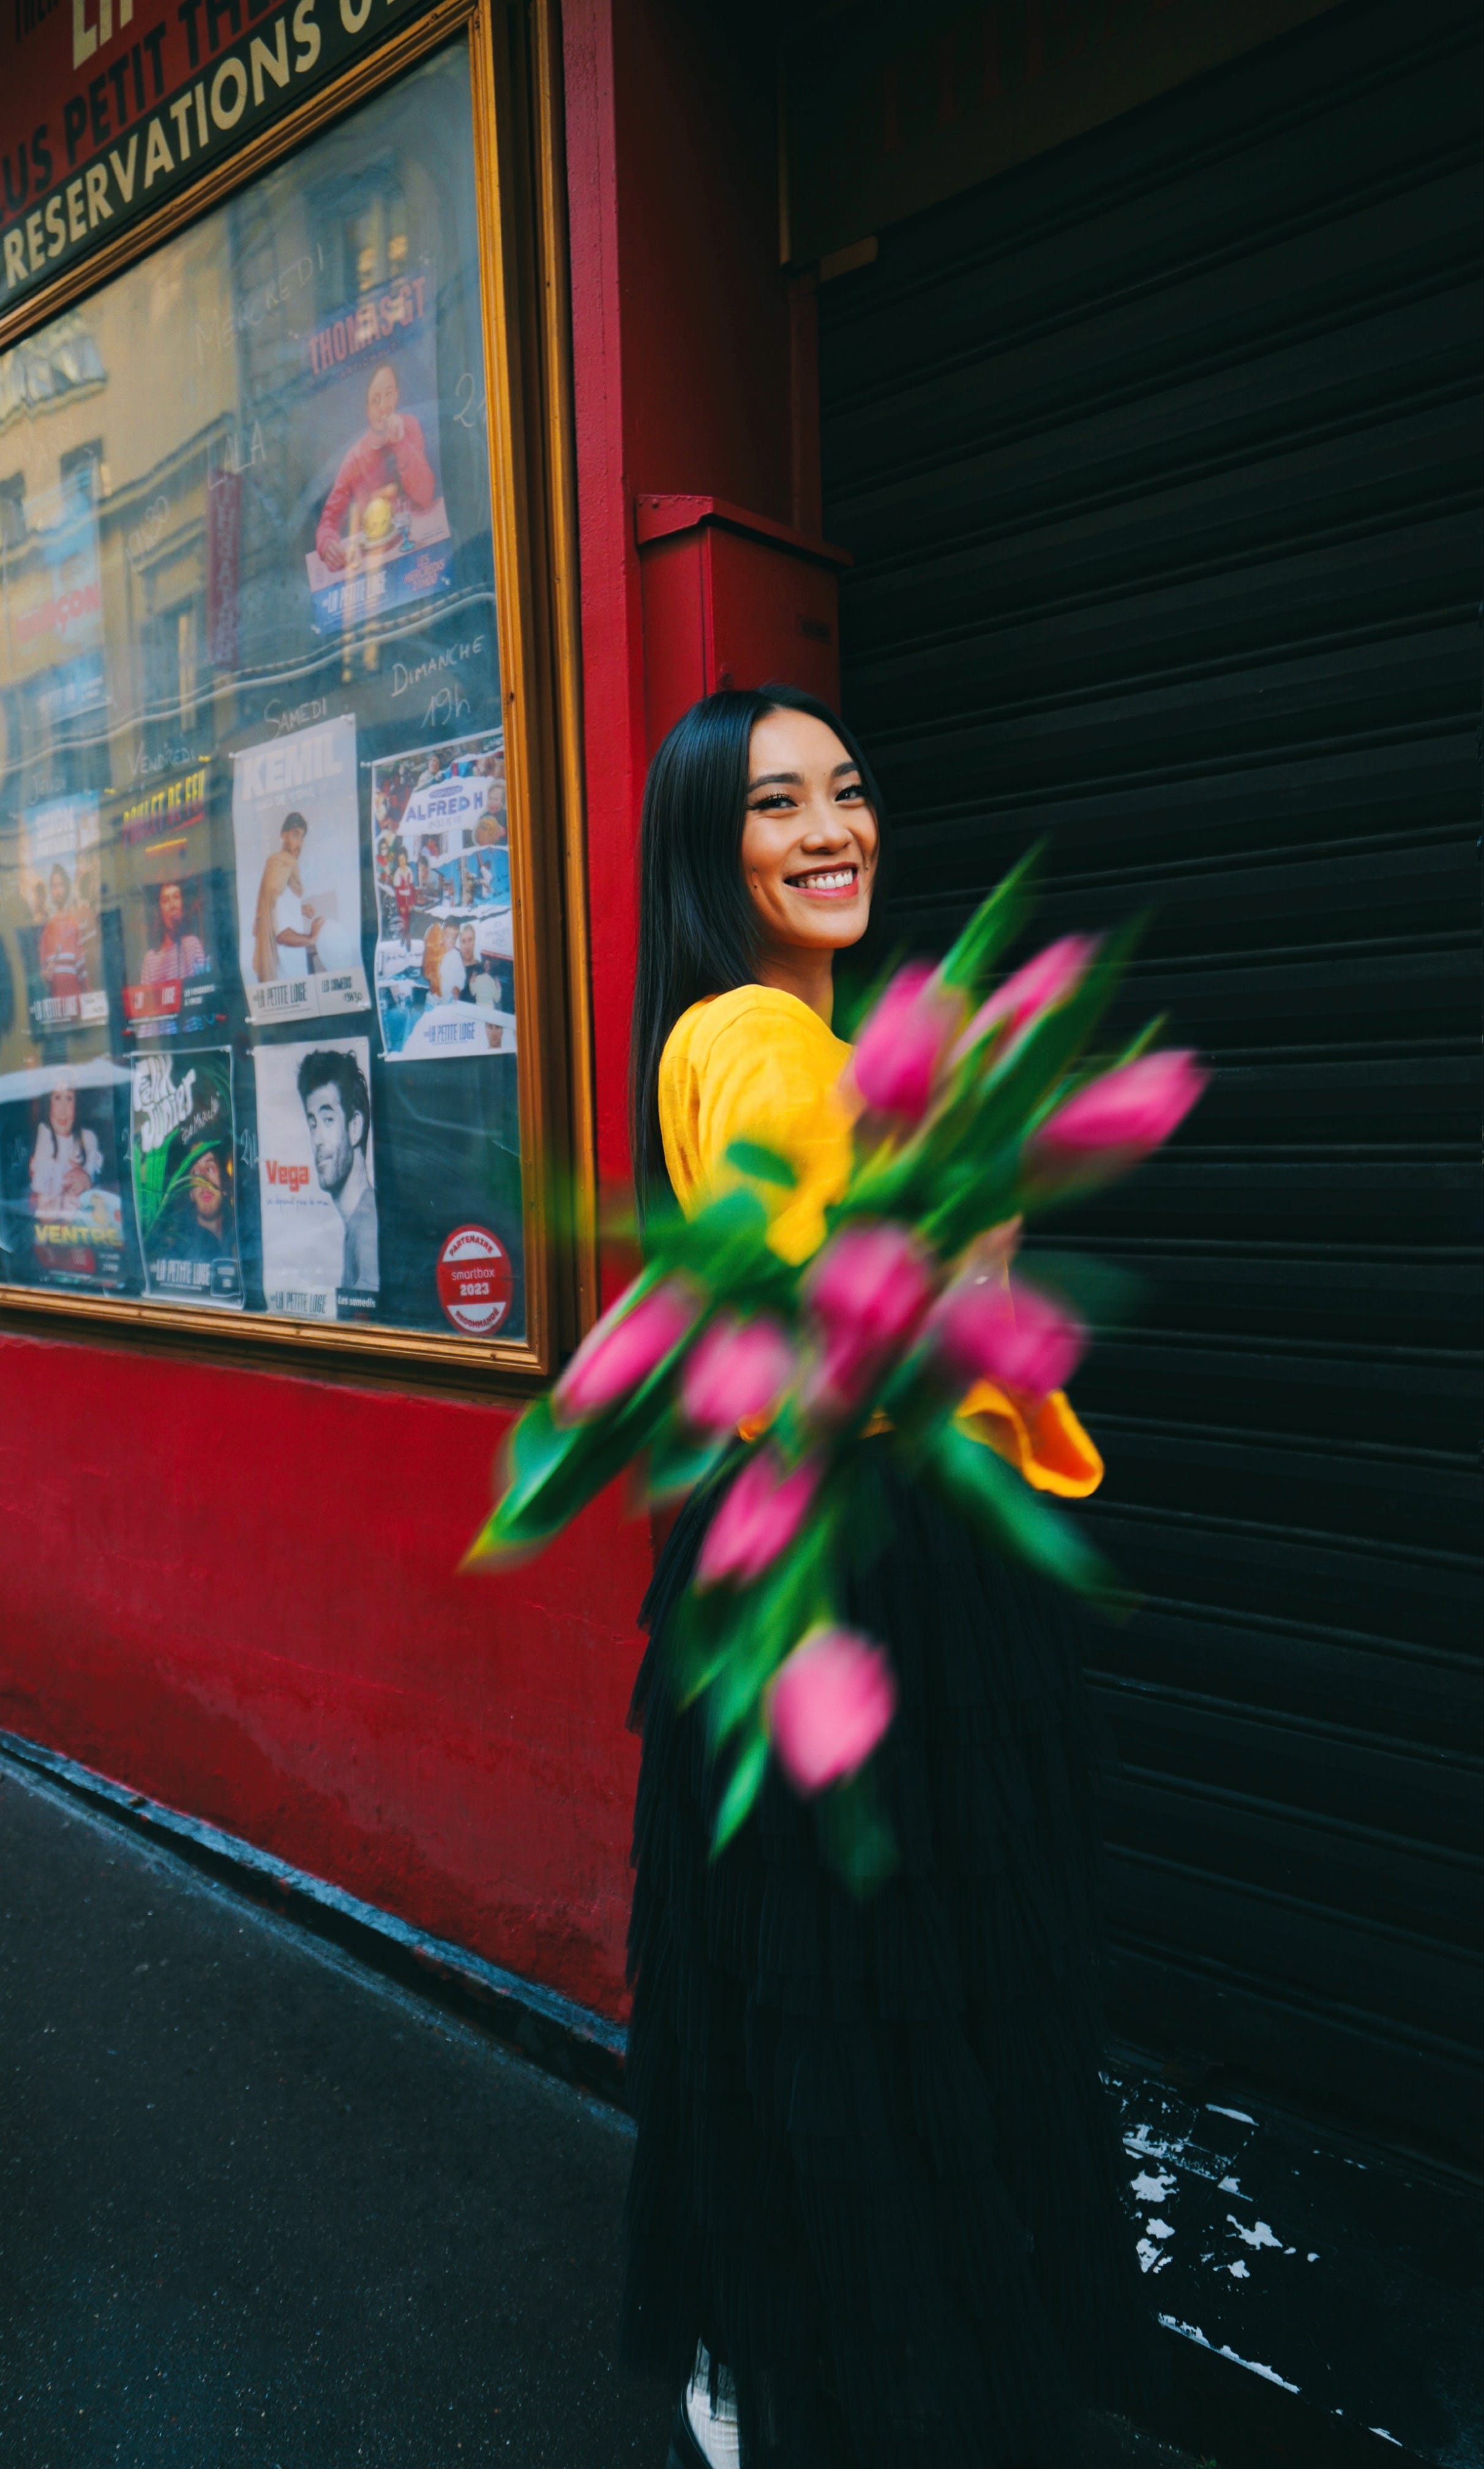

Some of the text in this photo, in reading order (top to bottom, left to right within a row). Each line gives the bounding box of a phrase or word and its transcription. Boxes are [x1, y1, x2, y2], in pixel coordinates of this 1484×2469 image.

[0, 124, 53, 224] US
[63, 21, 167, 168] PETIT
[3, 0, 321, 288] RESERVATIONS
[392, 634, 485, 697] DIMANCHE
[264, 698, 328, 738] SAMEDI
[242, 732, 343, 803] KEMIL
[405, 796, 470, 822] ALFRED
[473, 791, 482, 810] H
[266, 1160, 310, 1192] Vega
[34, 1224, 124, 1247] VENTRE
[449, 1235, 493, 1257] PARTENAIRE
[451, 1267, 495, 1281] smartbox
[460, 1282, 489, 1296] 2023
